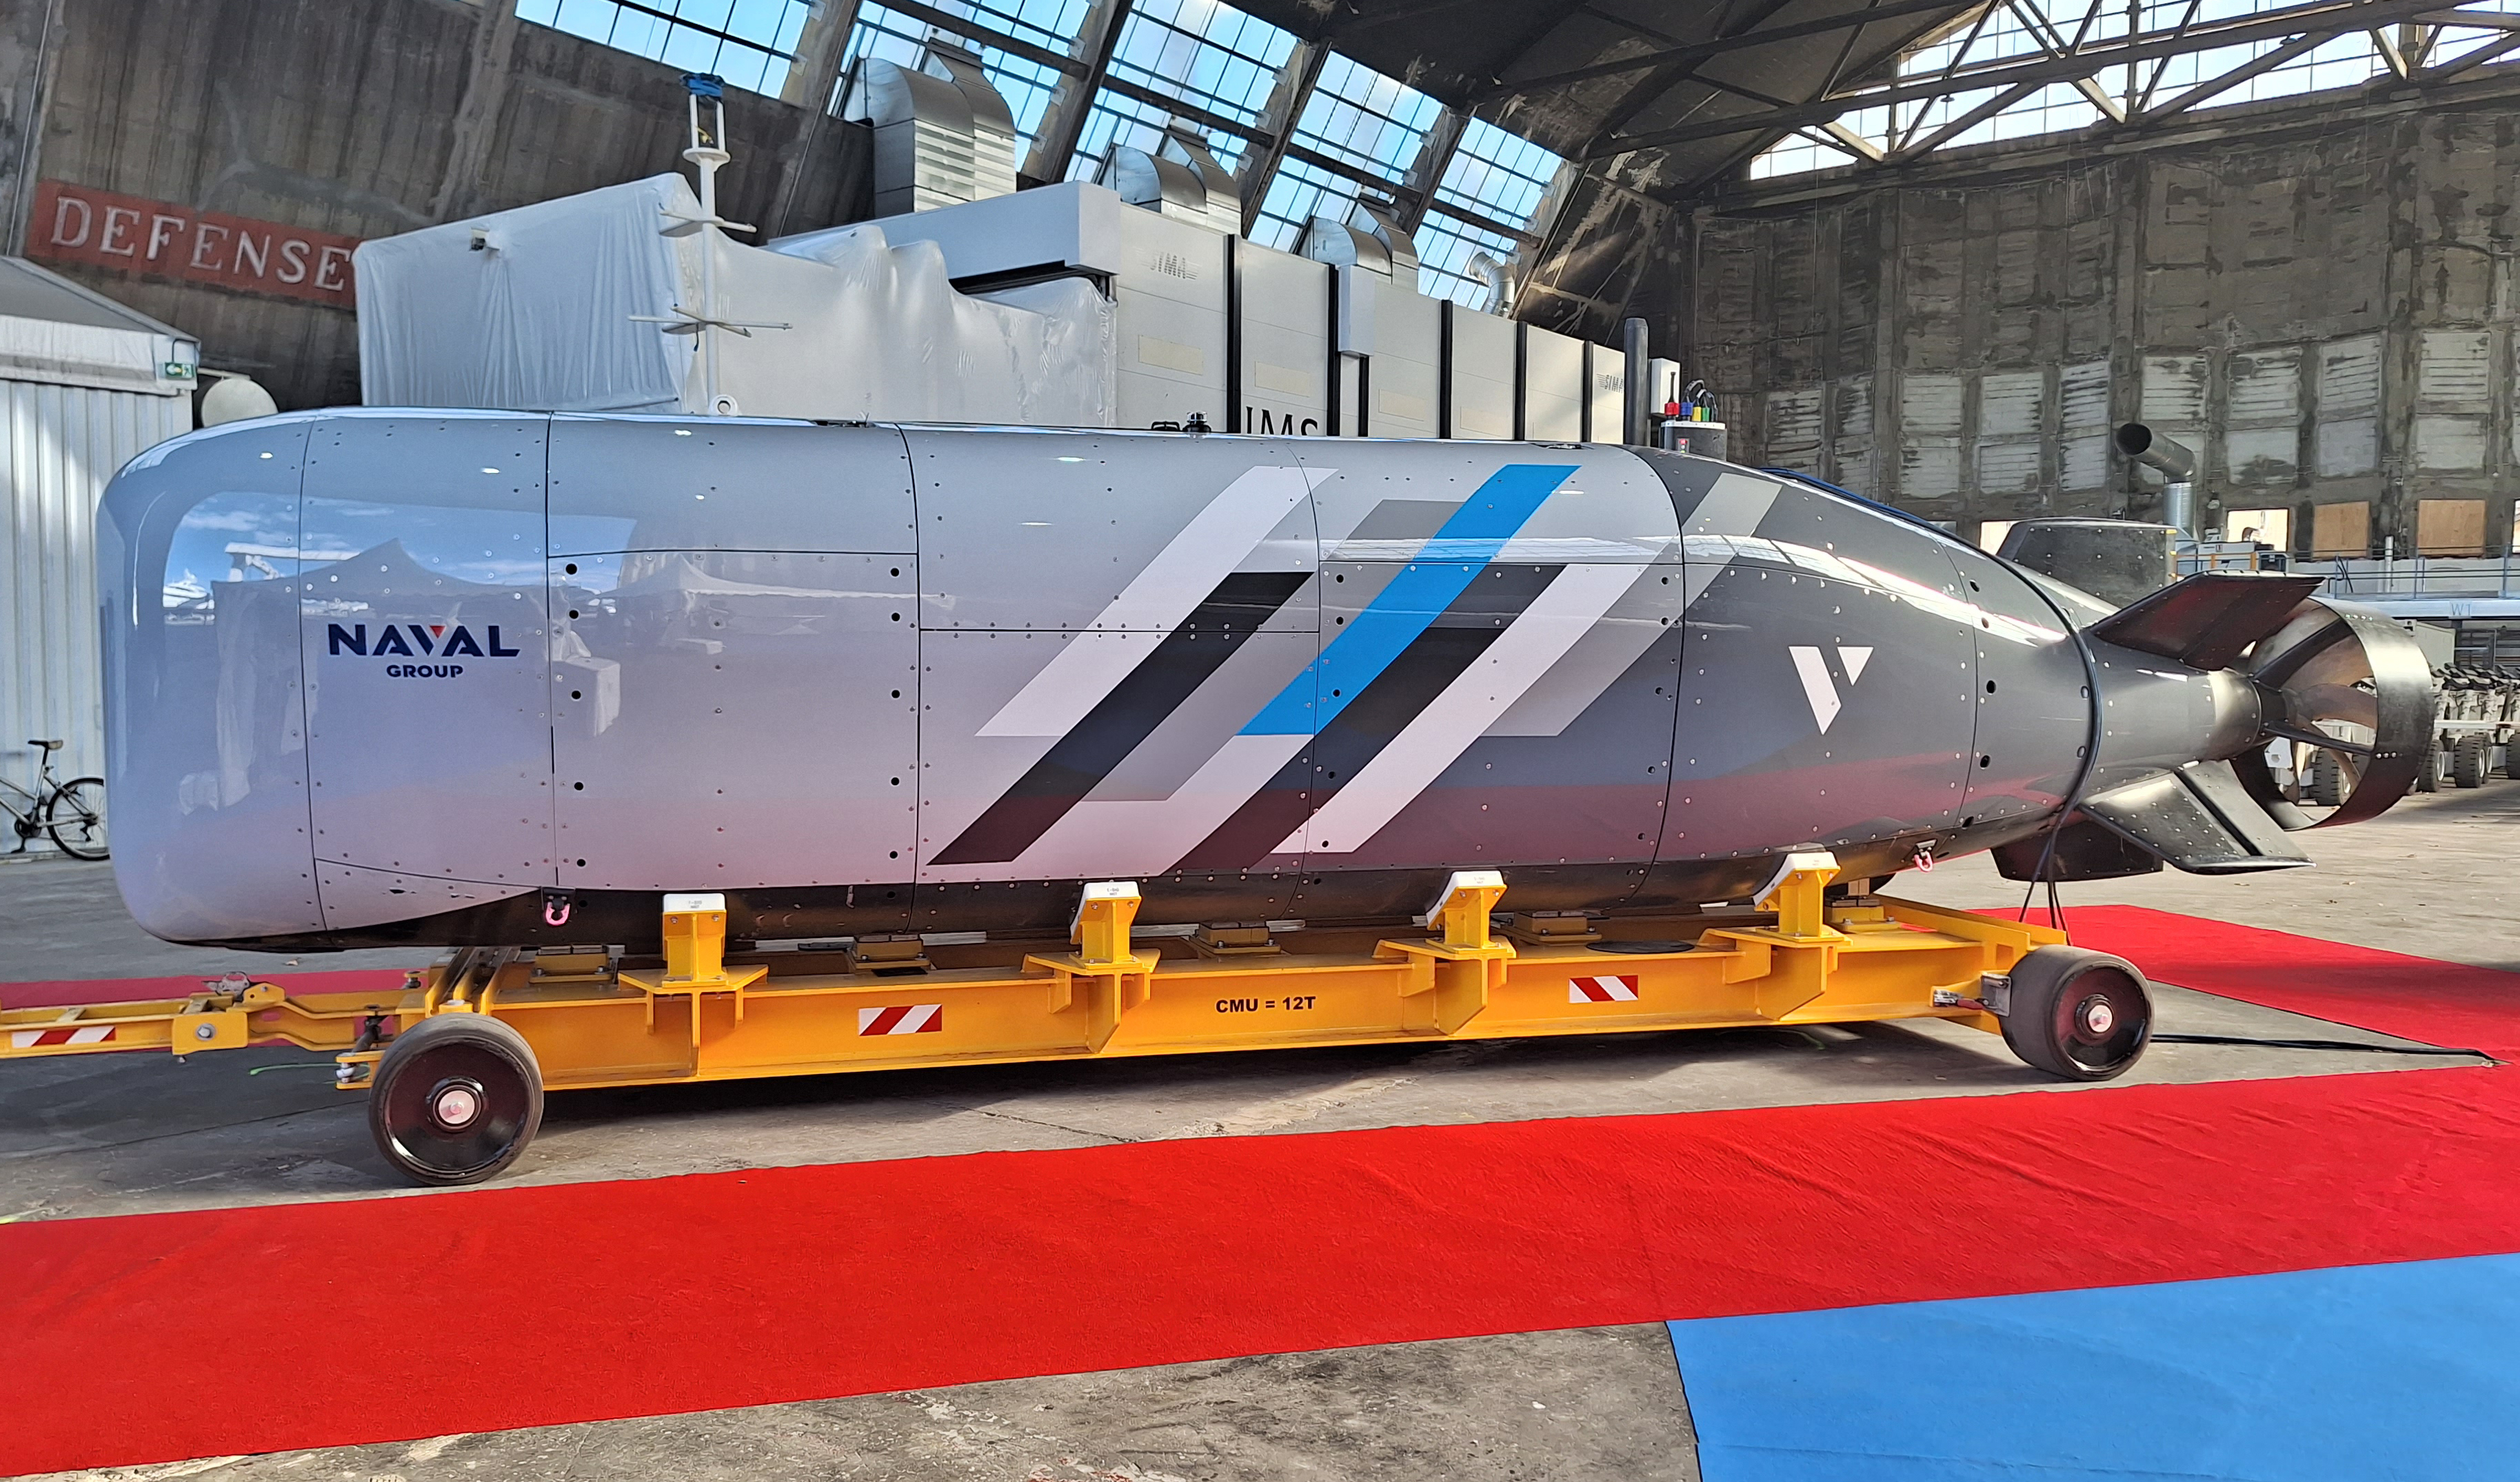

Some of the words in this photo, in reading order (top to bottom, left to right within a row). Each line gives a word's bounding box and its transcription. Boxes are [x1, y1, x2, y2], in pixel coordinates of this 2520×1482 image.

[50, 195, 351, 291] DEFENSE
[327, 624, 521, 657] NAVAL
[386, 664, 463, 678] GROUP
[1216, 998, 1258, 1013] CMU
[1282, 996, 1316, 1011] 12T
